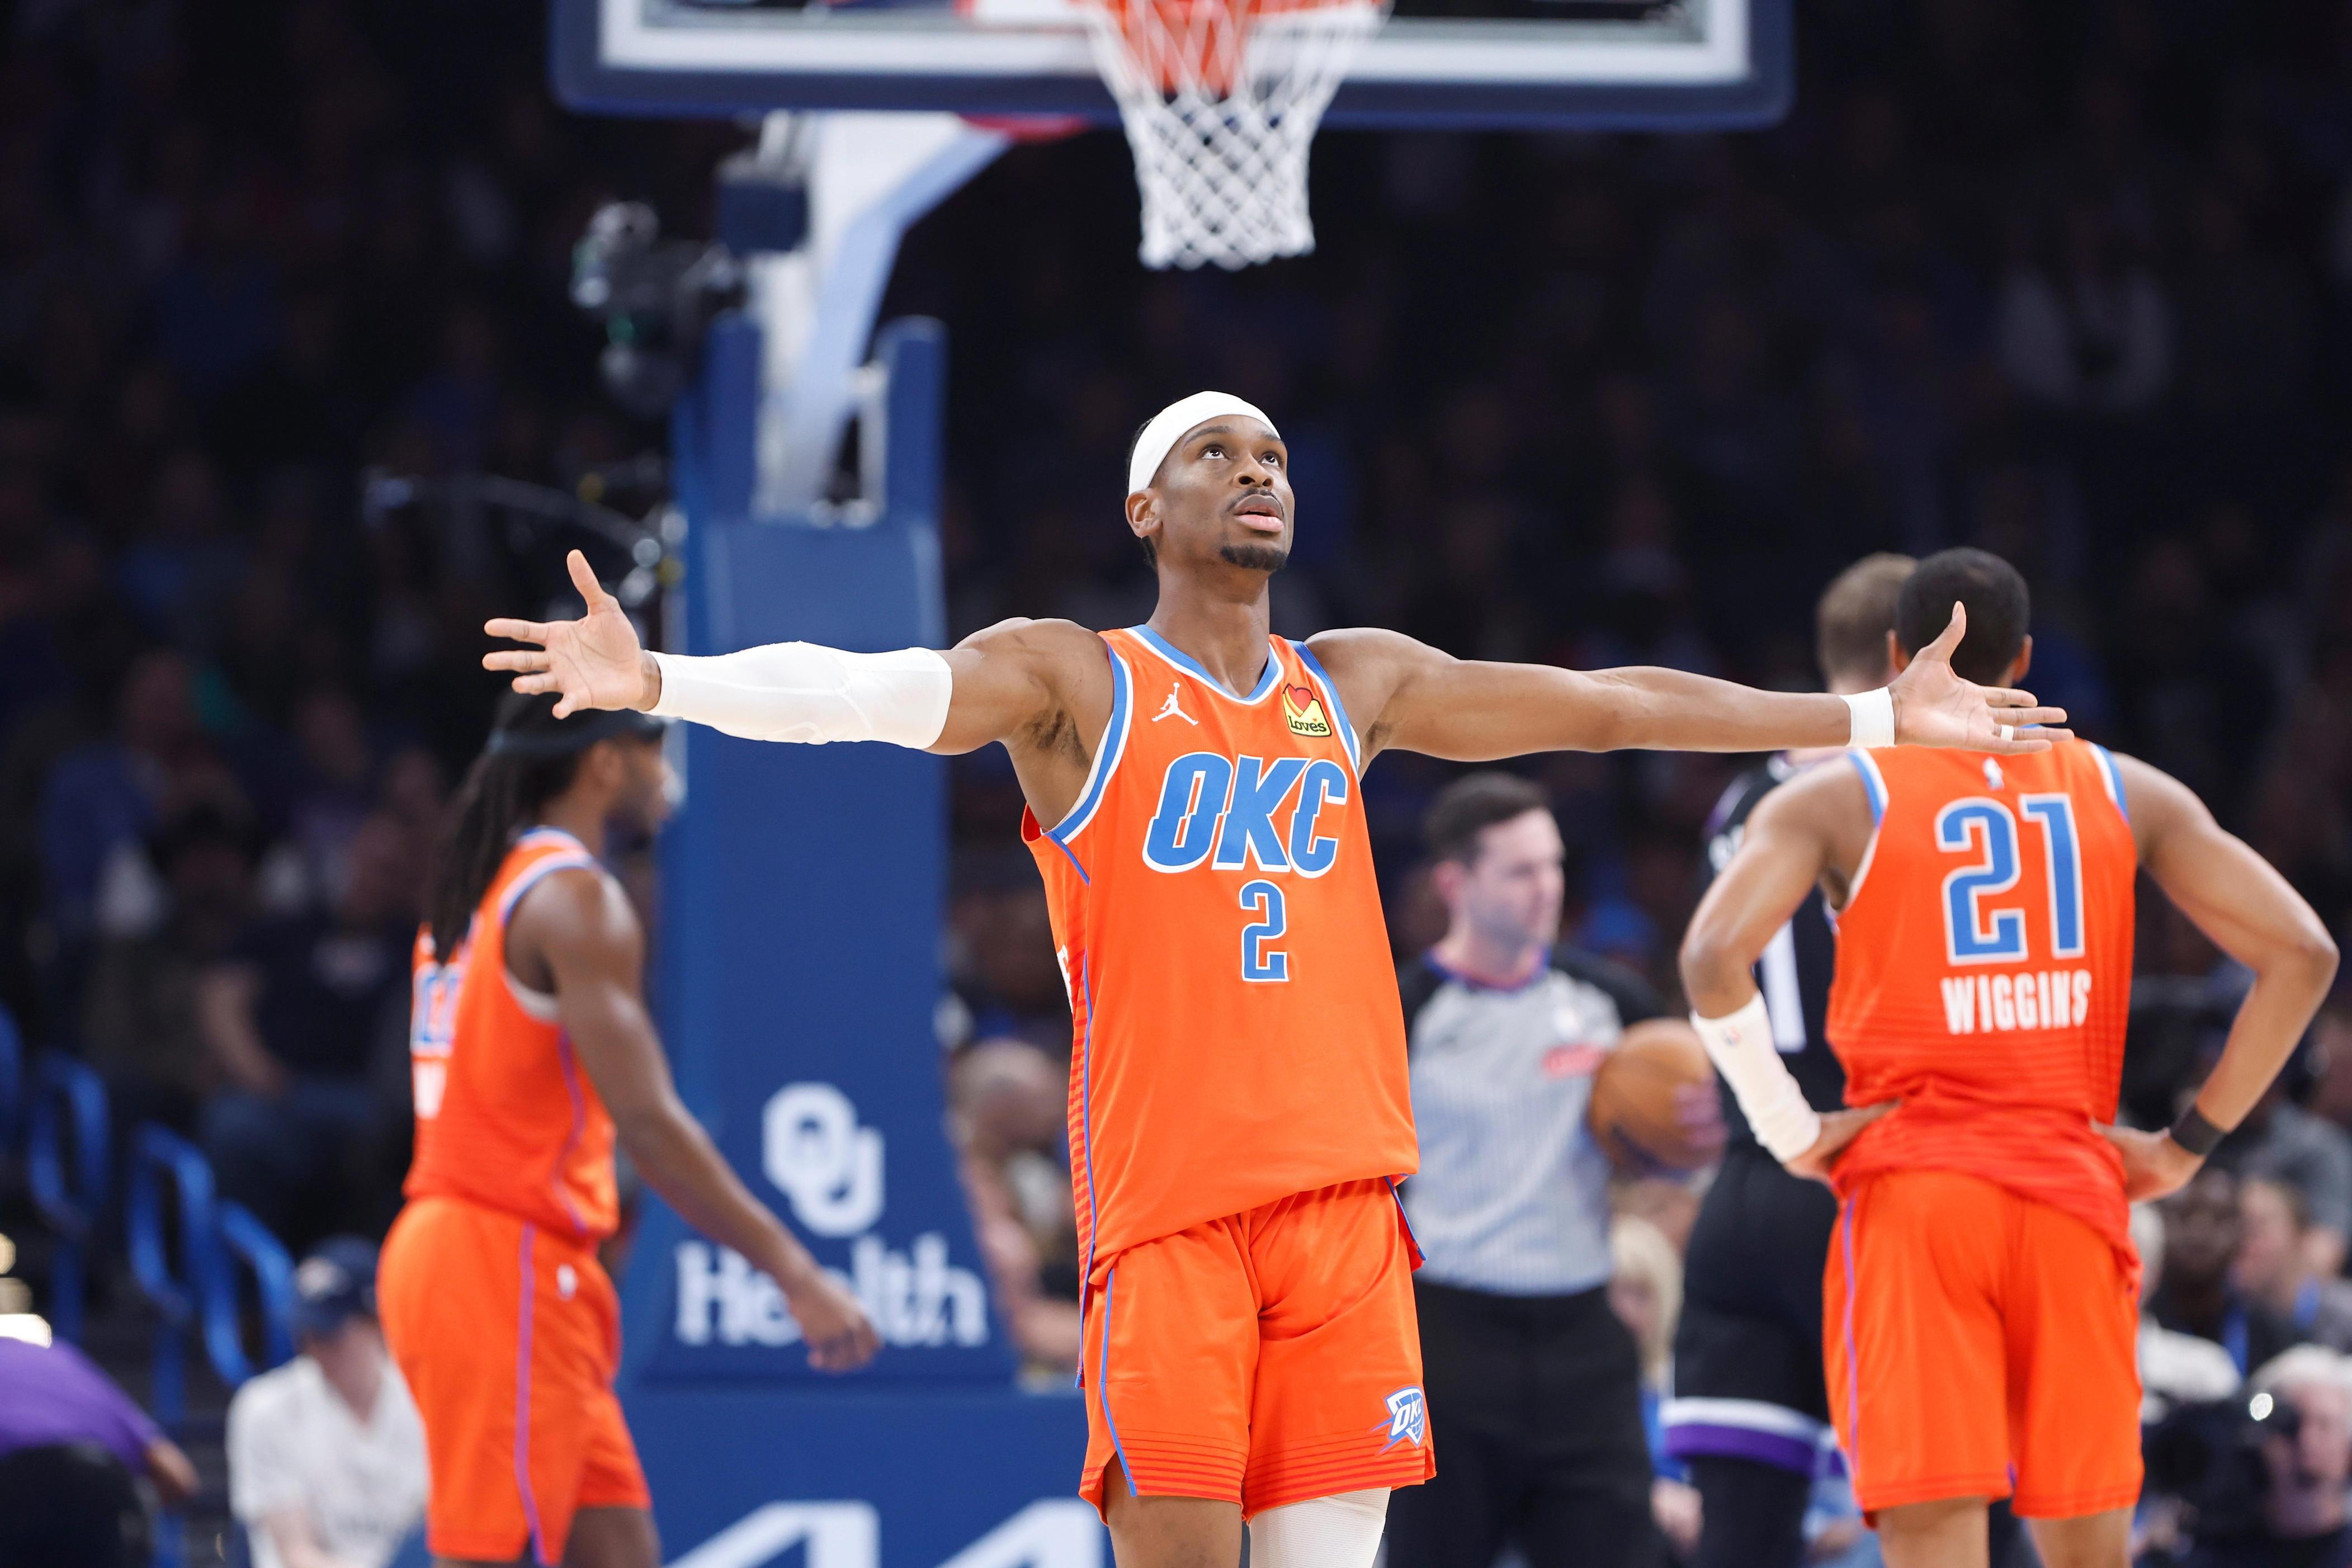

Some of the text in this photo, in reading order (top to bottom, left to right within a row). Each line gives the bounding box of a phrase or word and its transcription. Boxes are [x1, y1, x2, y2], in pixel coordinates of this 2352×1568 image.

[1142, 752, 1348, 879] OKC
[1240, 879, 1289, 982] 2
[1934, 792, 2085, 966] 21
[1939, 969, 2092, 1035] WIGGINS
[676, 1234, 989, 1347] Helth
[1391, 1397, 1422, 1437] OKC
